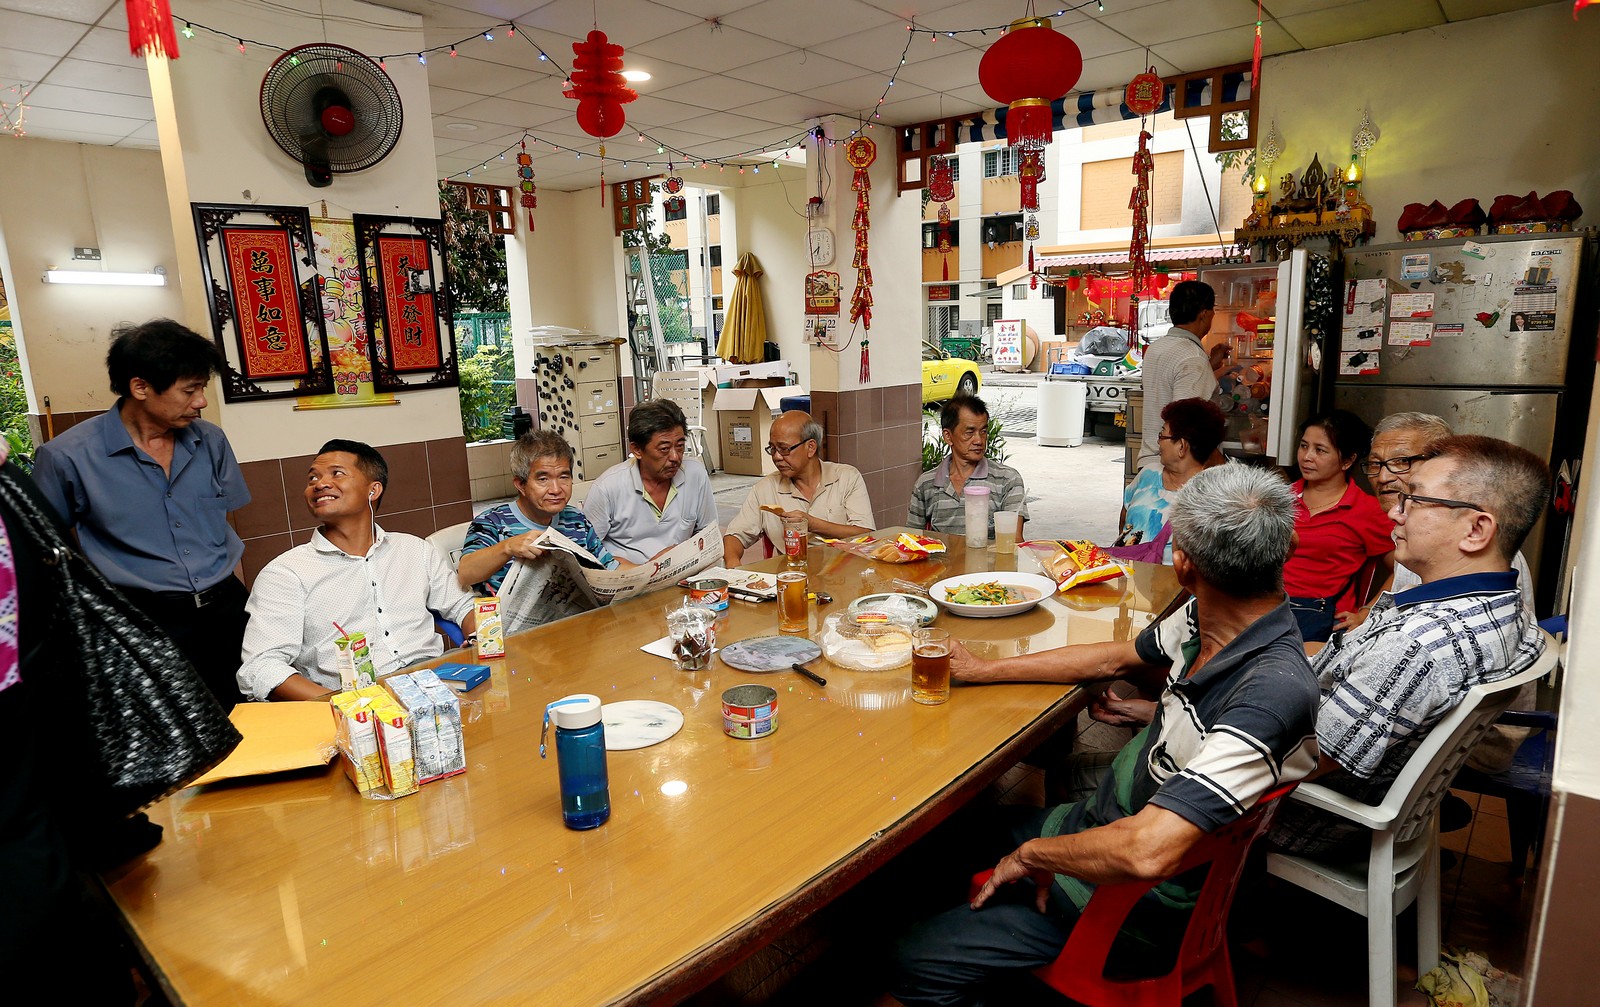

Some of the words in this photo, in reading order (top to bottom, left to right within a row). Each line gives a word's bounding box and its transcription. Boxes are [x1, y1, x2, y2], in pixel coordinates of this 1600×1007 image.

[250, 250, 287, 351] 萬事如意
[805, 320, 814, 328] 21
[827, 320, 836, 328] 22
